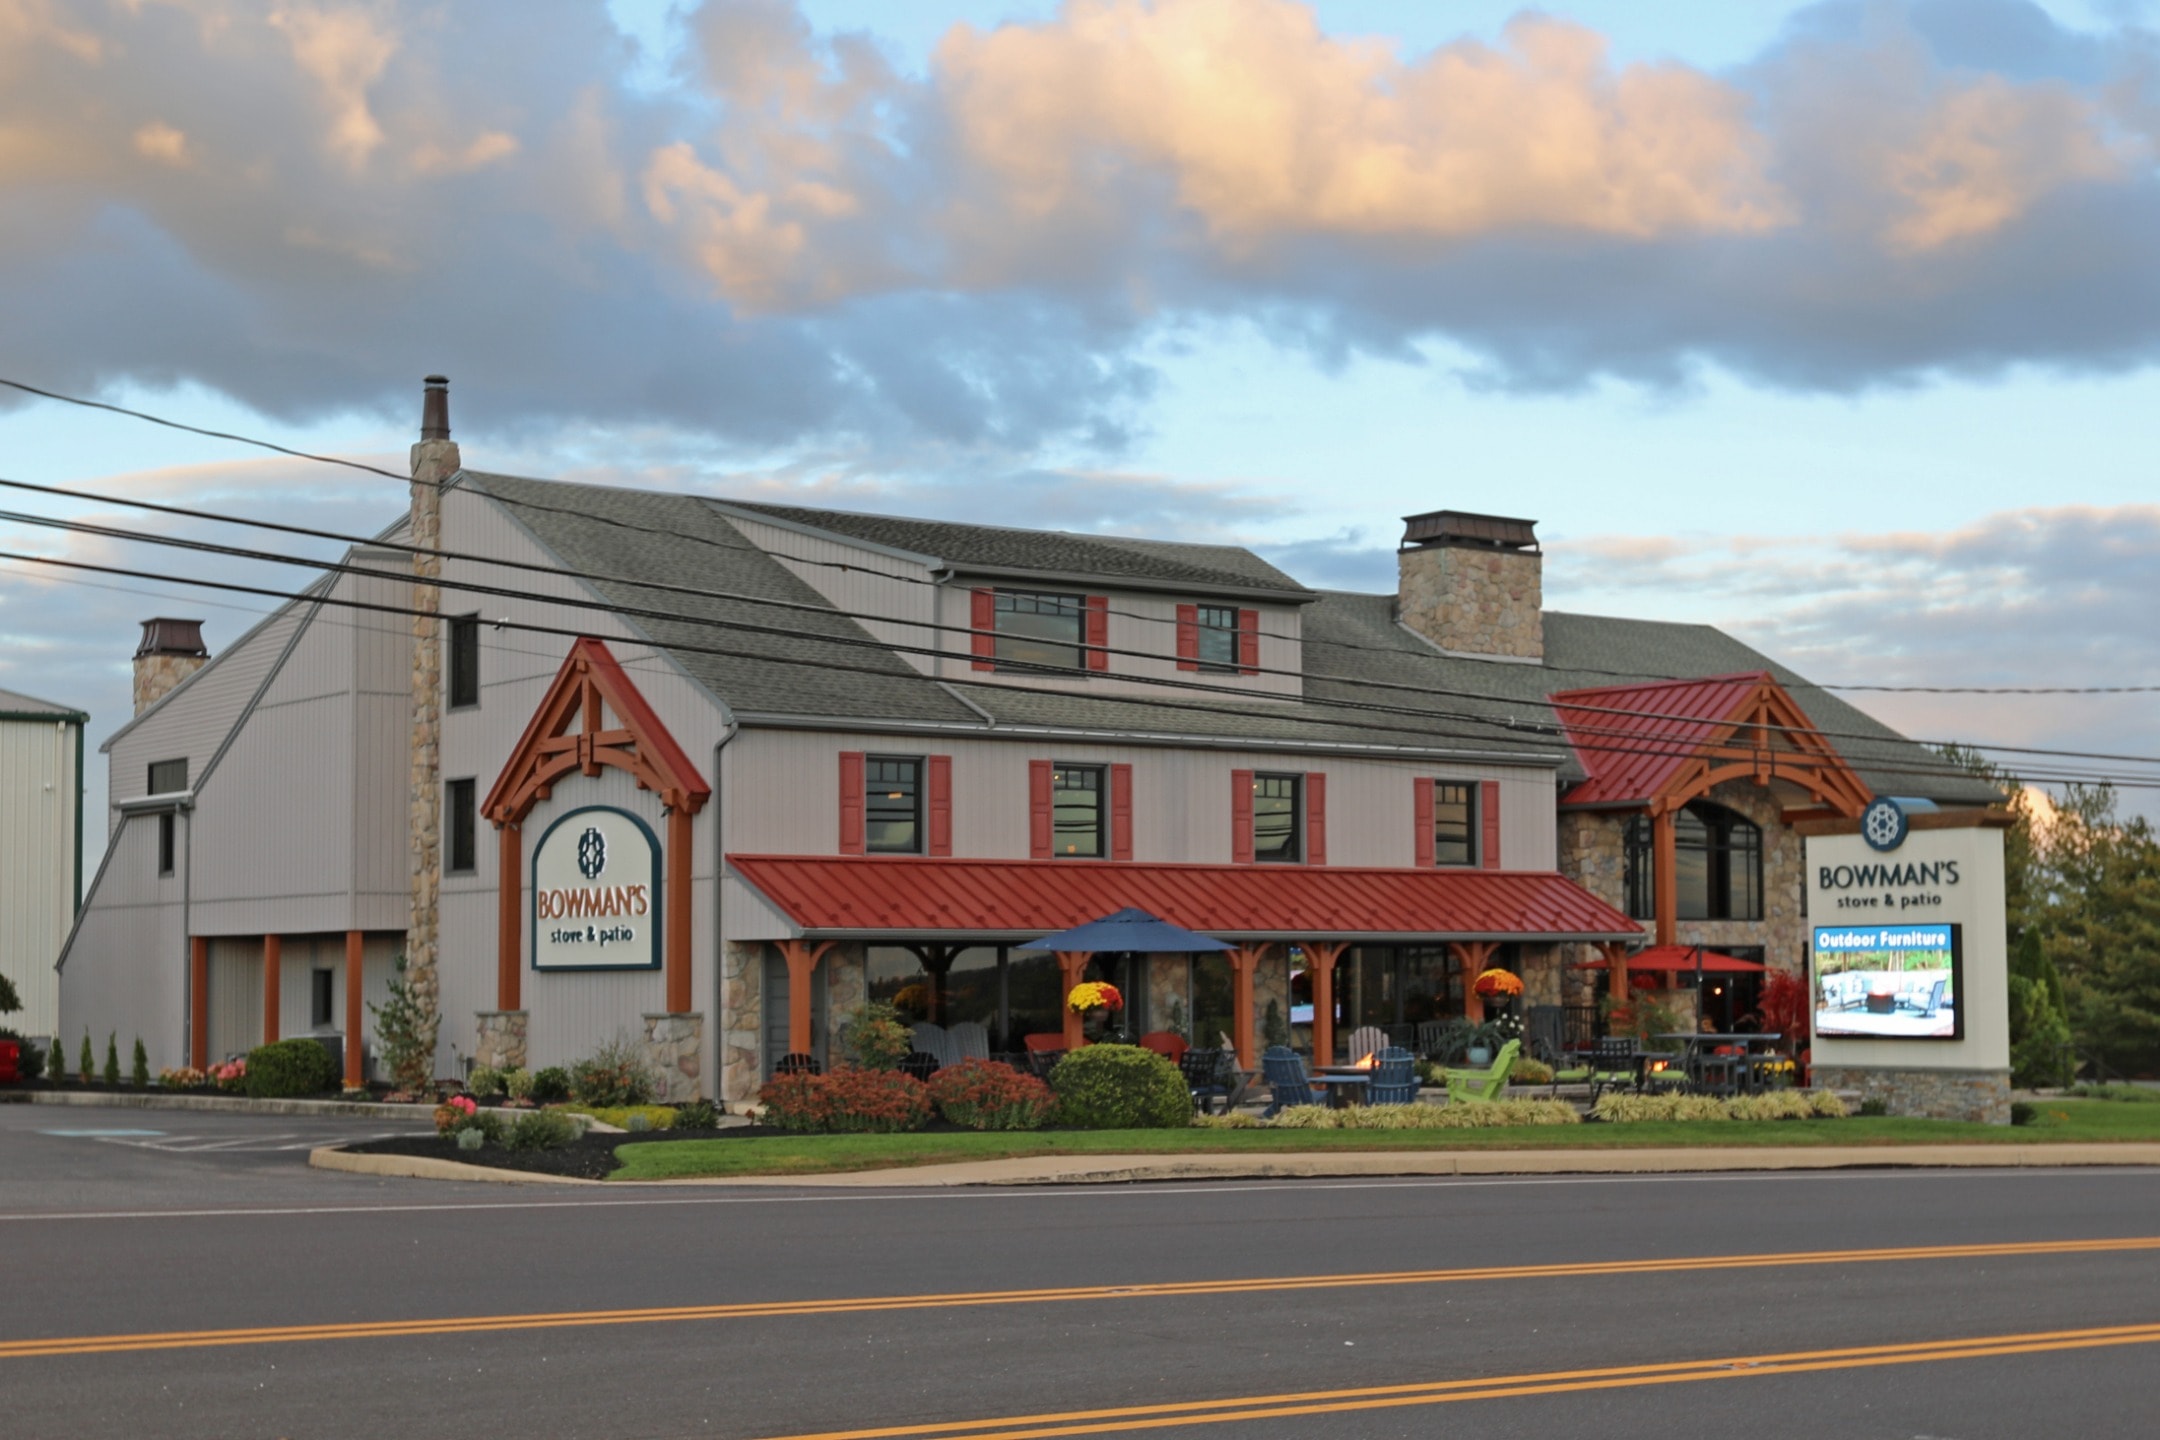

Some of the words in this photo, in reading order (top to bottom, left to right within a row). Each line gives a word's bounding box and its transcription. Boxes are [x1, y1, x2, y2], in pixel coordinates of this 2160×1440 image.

[1819, 860, 1960, 890] BOWMAN'S
[538, 884, 648, 919] BOWMAN'S
[1837, 894, 1878, 908] stove
[1885, 893, 1894, 906] &
[1901, 892, 1942, 910] patio
[551, 928, 583, 944] stove
[587, 926, 595, 942] &
[600, 925, 633, 947] patio
[1819, 931, 1876, 948] Outdoor
[1880, 930, 1946, 947] Furniture
